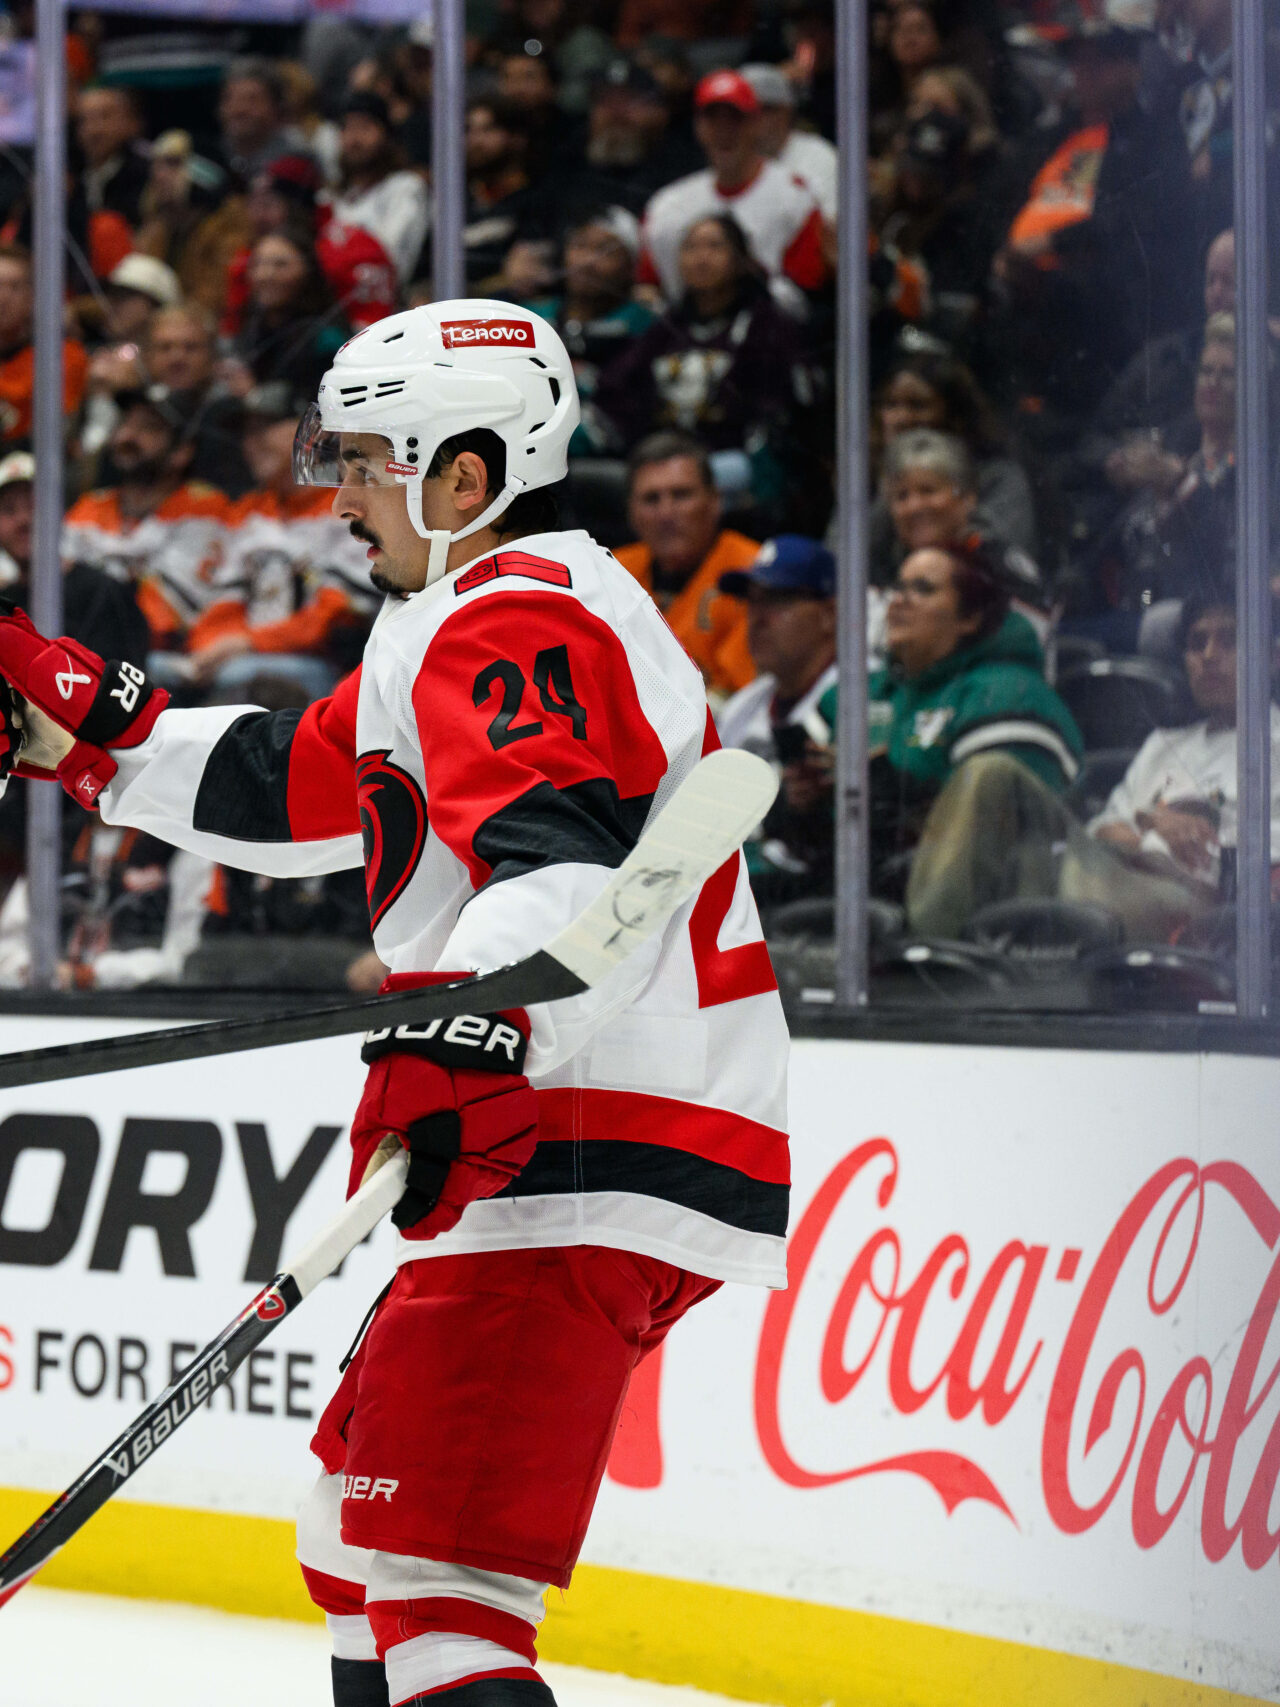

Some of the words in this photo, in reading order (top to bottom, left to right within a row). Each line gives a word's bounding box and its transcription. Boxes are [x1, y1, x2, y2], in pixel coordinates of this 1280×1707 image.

[449, 326, 528, 341] Lenovo
[473, 644, 588, 752] 24
[36, 1329, 149, 1402] FOR
[131, 1349, 230, 1467] BAUER
